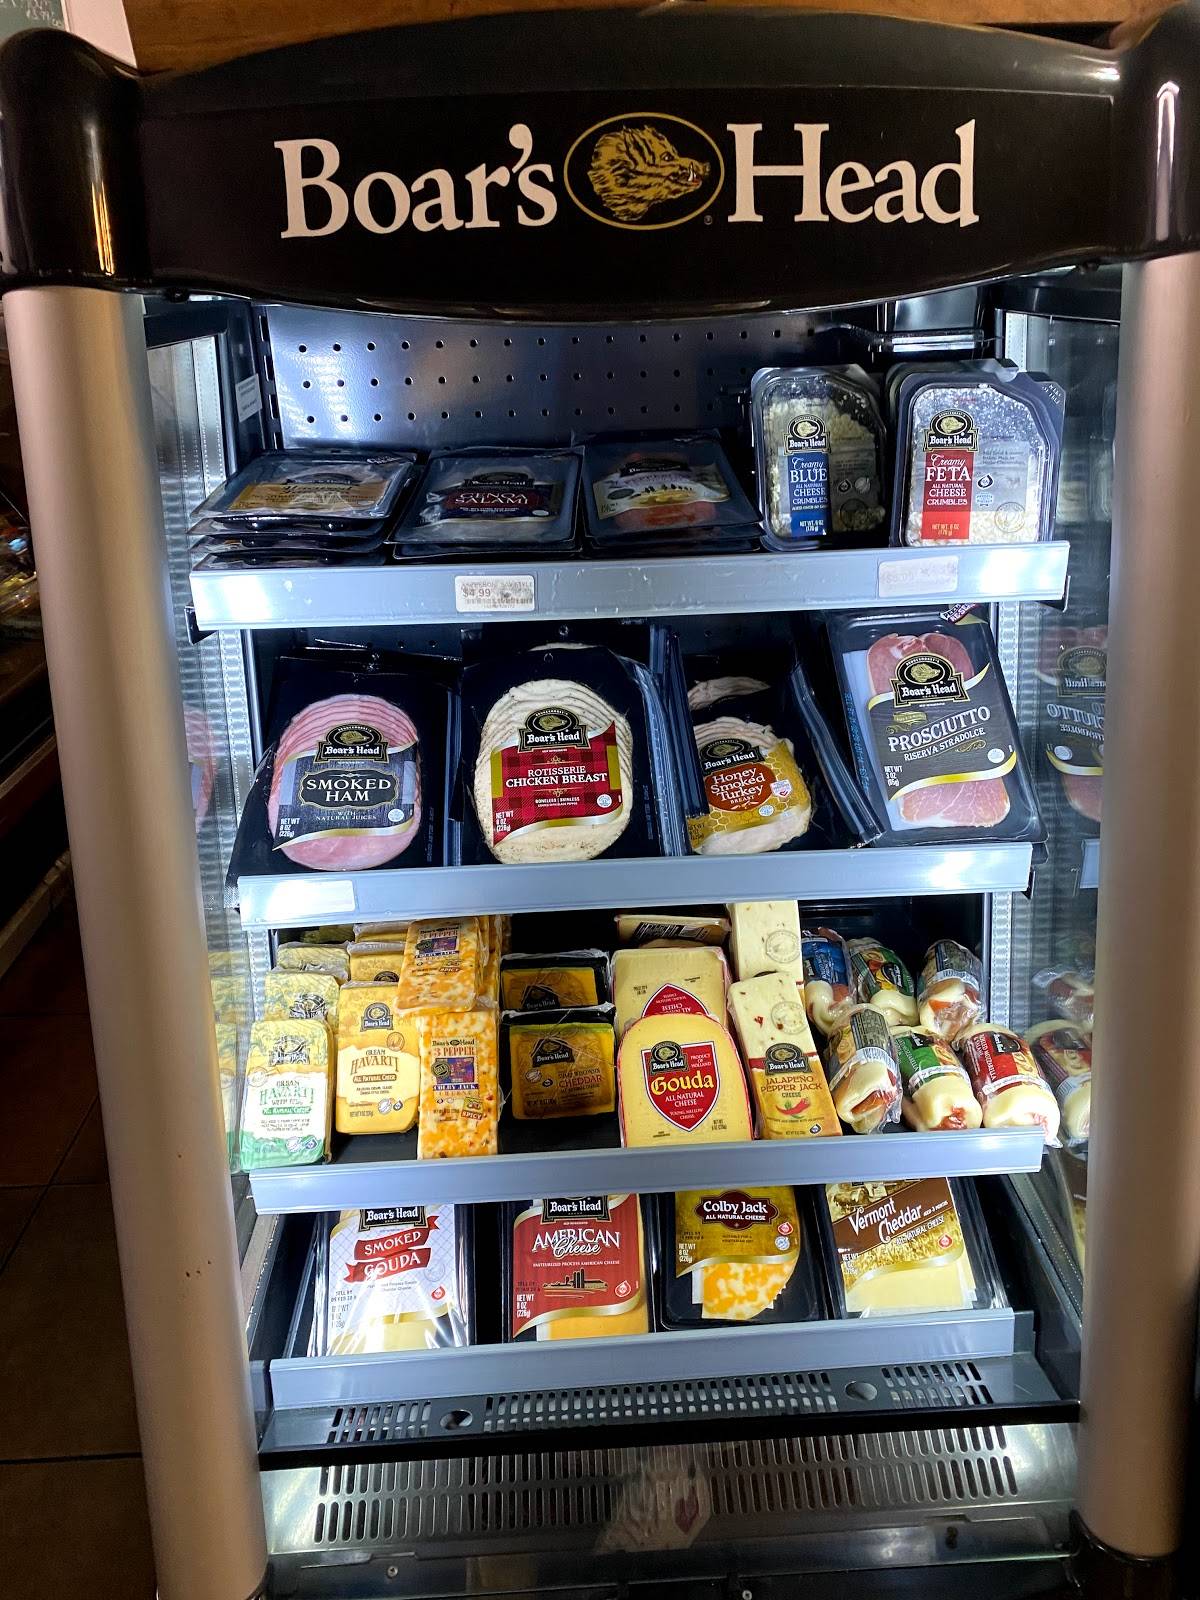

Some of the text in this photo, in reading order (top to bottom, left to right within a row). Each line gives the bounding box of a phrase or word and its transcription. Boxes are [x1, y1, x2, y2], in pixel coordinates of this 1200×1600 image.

[273, 118, 979, 239] Boar's Head
[930, 434, 972, 445] Boar's Head
[792, 457, 824, 472] Creamy
[931, 454, 966, 470] Creamy
[790, 468, 827, 483] BLUE
[925, 466, 971, 482] FETA
[793, 488, 826, 497] CHEESE
[929, 489, 967, 497] CHEESE
[901, 683, 957, 698] Boar's Head
[888, 706, 991, 752] PROSCIUTTO
[526, 731, 580, 744] Boar's Head
[904, 727, 986, 761] RISERVA STRADOLCE
[324, 744, 380, 756] Boar's Head
[704, 752, 755, 770] Boar's Head
[528, 766, 586, 777] ROTISSERIE
[712, 767, 757, 784] Honey
[306, 779, 391, 790] SMOKED
[506, 773, 607, 788] CHICKEN BREAST
[711, 773, 766, 794] Smoked
[325, 790, 369, 802] HAM
[716, 785, 763, 802] Turkey
[496, 810, 514, 819] NET WT
[434, 1046, 474, 1056] 3 PEPPER
[350, 1056, 399, 1076] HAVARTI
[789, 1060, 805, 1068] Head
[558, 1075, 602, 1088] CHEDDAR
[651, 1070, 714, 1096] Gouda
[760, 1083, 823, 1093] PEPPER JACK
[664, 1091, 704, 1102] ALL NATURAL
[674, 1099, 697, 1108] CHEESE
[462, 1110, 482, 1120] SPICY
[550, 1200, 602, 1212] Boar's Head
[703, 1201, 768, 1214] Colby Jack
[366, 1206, 418, 1222] Boar's Head
[848, 1197, 897, 1236] Vermont
[878, 1205, 922, 1244] Cheddar
[364, 1231, 421, 1255] SMOKED
[532, 1228, 620, 1252] AMERICAN
[554, 1238, 600, 1260] Cheese
[364, 1252, 421, 1279] GOUDA
[516, 1294, 534, 1302] NET WT
